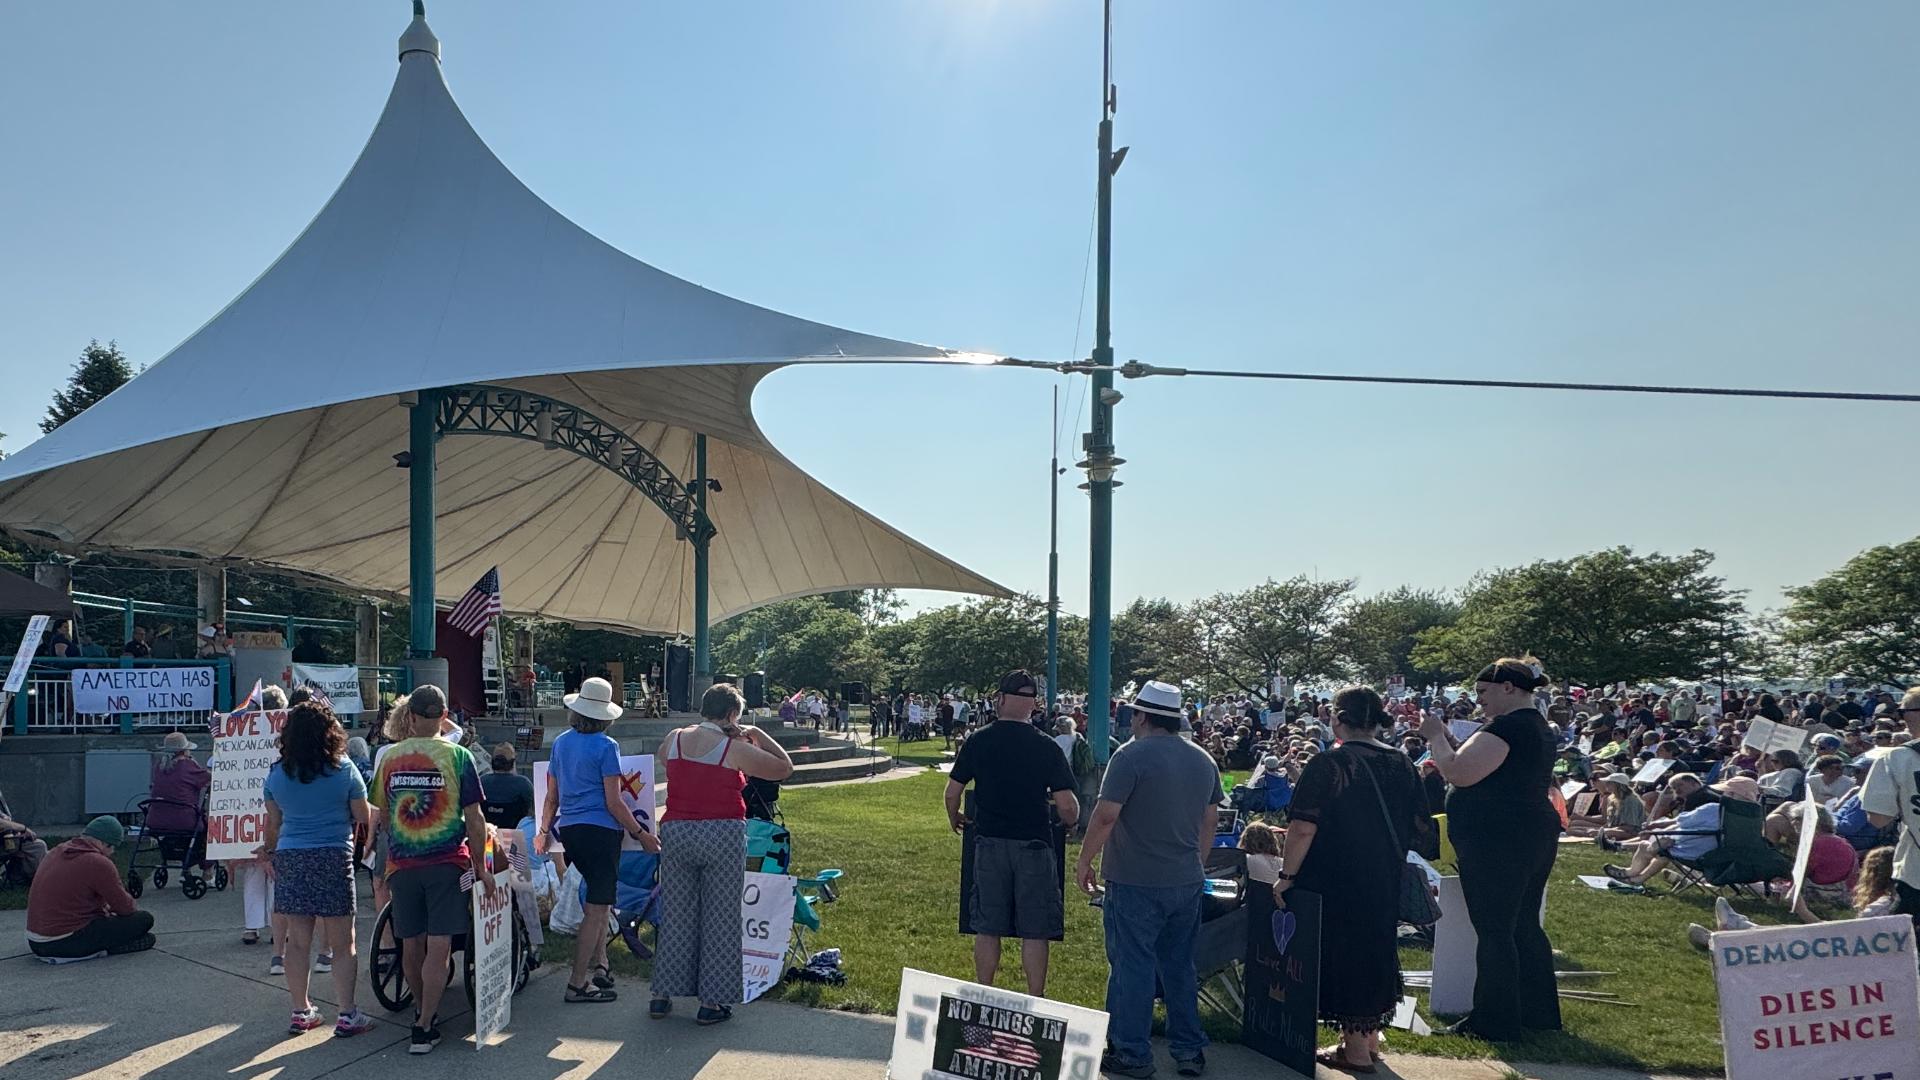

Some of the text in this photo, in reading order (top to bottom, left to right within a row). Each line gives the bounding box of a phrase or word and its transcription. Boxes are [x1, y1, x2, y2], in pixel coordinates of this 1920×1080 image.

[80, 670, 211, 690] AMERICA HAS
[107, 692, 193, 711] NO KING
[265, 711, 288, 735] YO
[479, 881, 510, 920] HANDS
[743, 883, 761, 906] O
[484, 913, 502, 946] OFF
[746, 917, 770, 940] GS
[1722, 931, 1909, 967] DEMOCRACY
[1760, 981, 1885, 1017] DIES IN
[946, 998, 973, 1022] NO
[978, 1005, 1036, 1037] KINGS
[1041, 1020, 1064, 1042] IN
[1753, 1014, 1896, 1051] SILENCE
